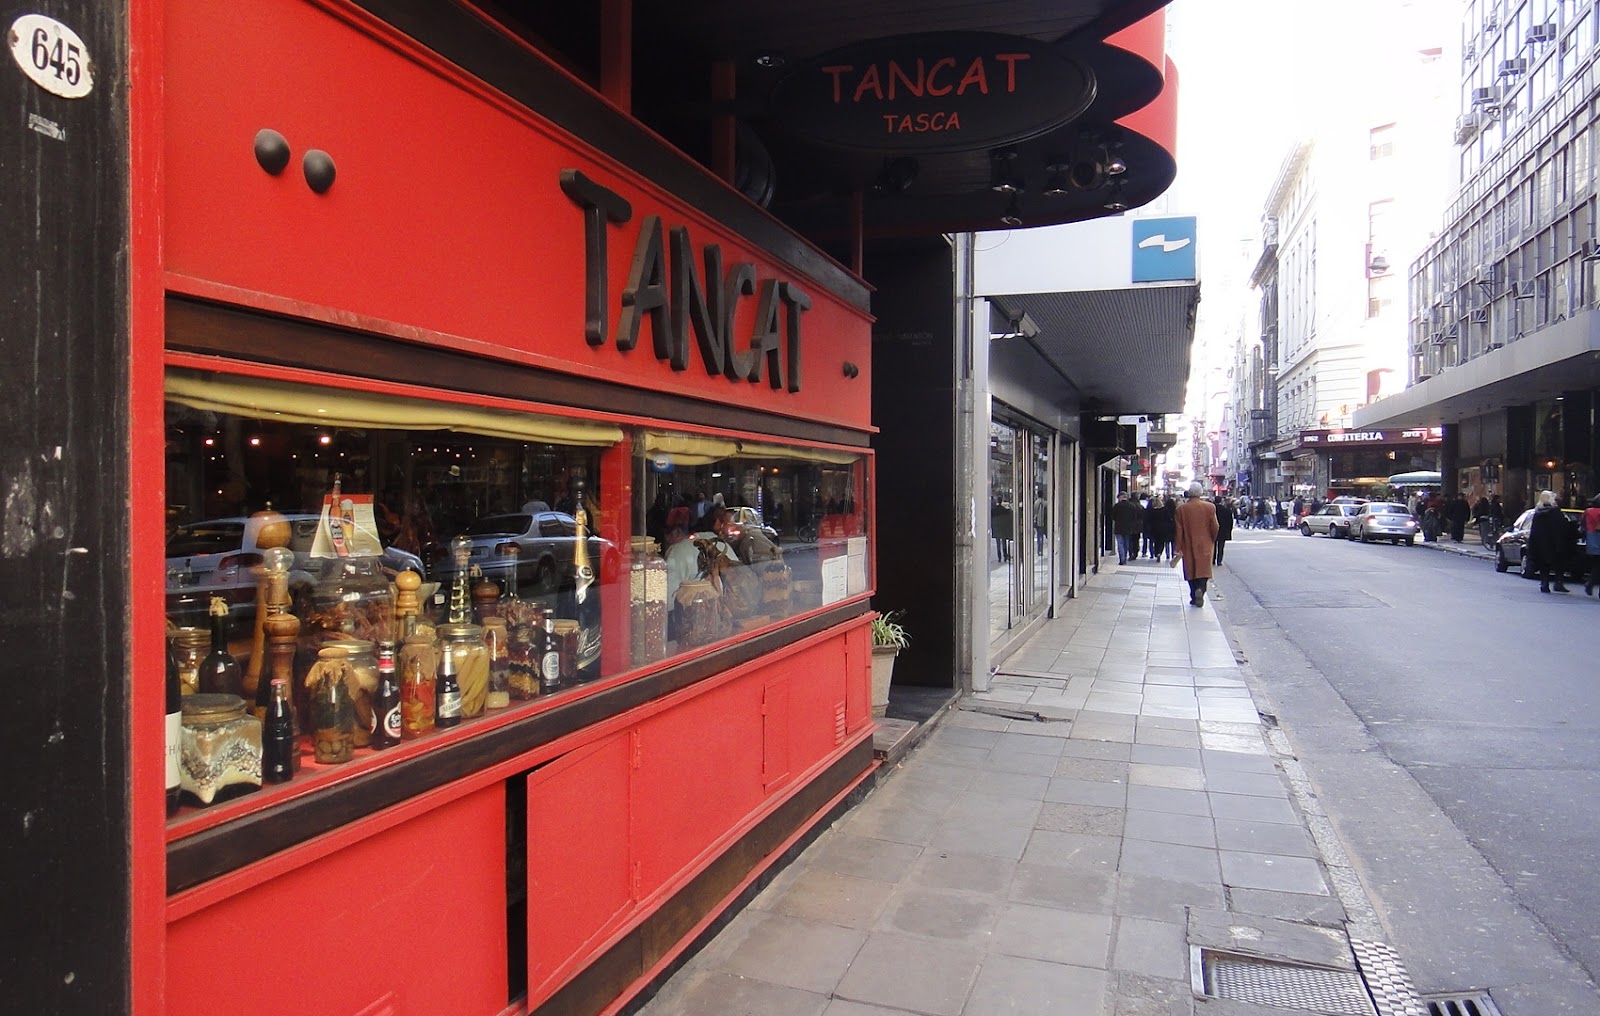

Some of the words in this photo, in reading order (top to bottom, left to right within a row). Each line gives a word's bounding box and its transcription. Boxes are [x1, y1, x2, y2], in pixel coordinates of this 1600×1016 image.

[32, 28, 80, 86] 645
[821, 53, 1031, 104] TANCAT
[883, 111, 961, 134] TASCA
[559, 168, 812, 393] TANCAT
